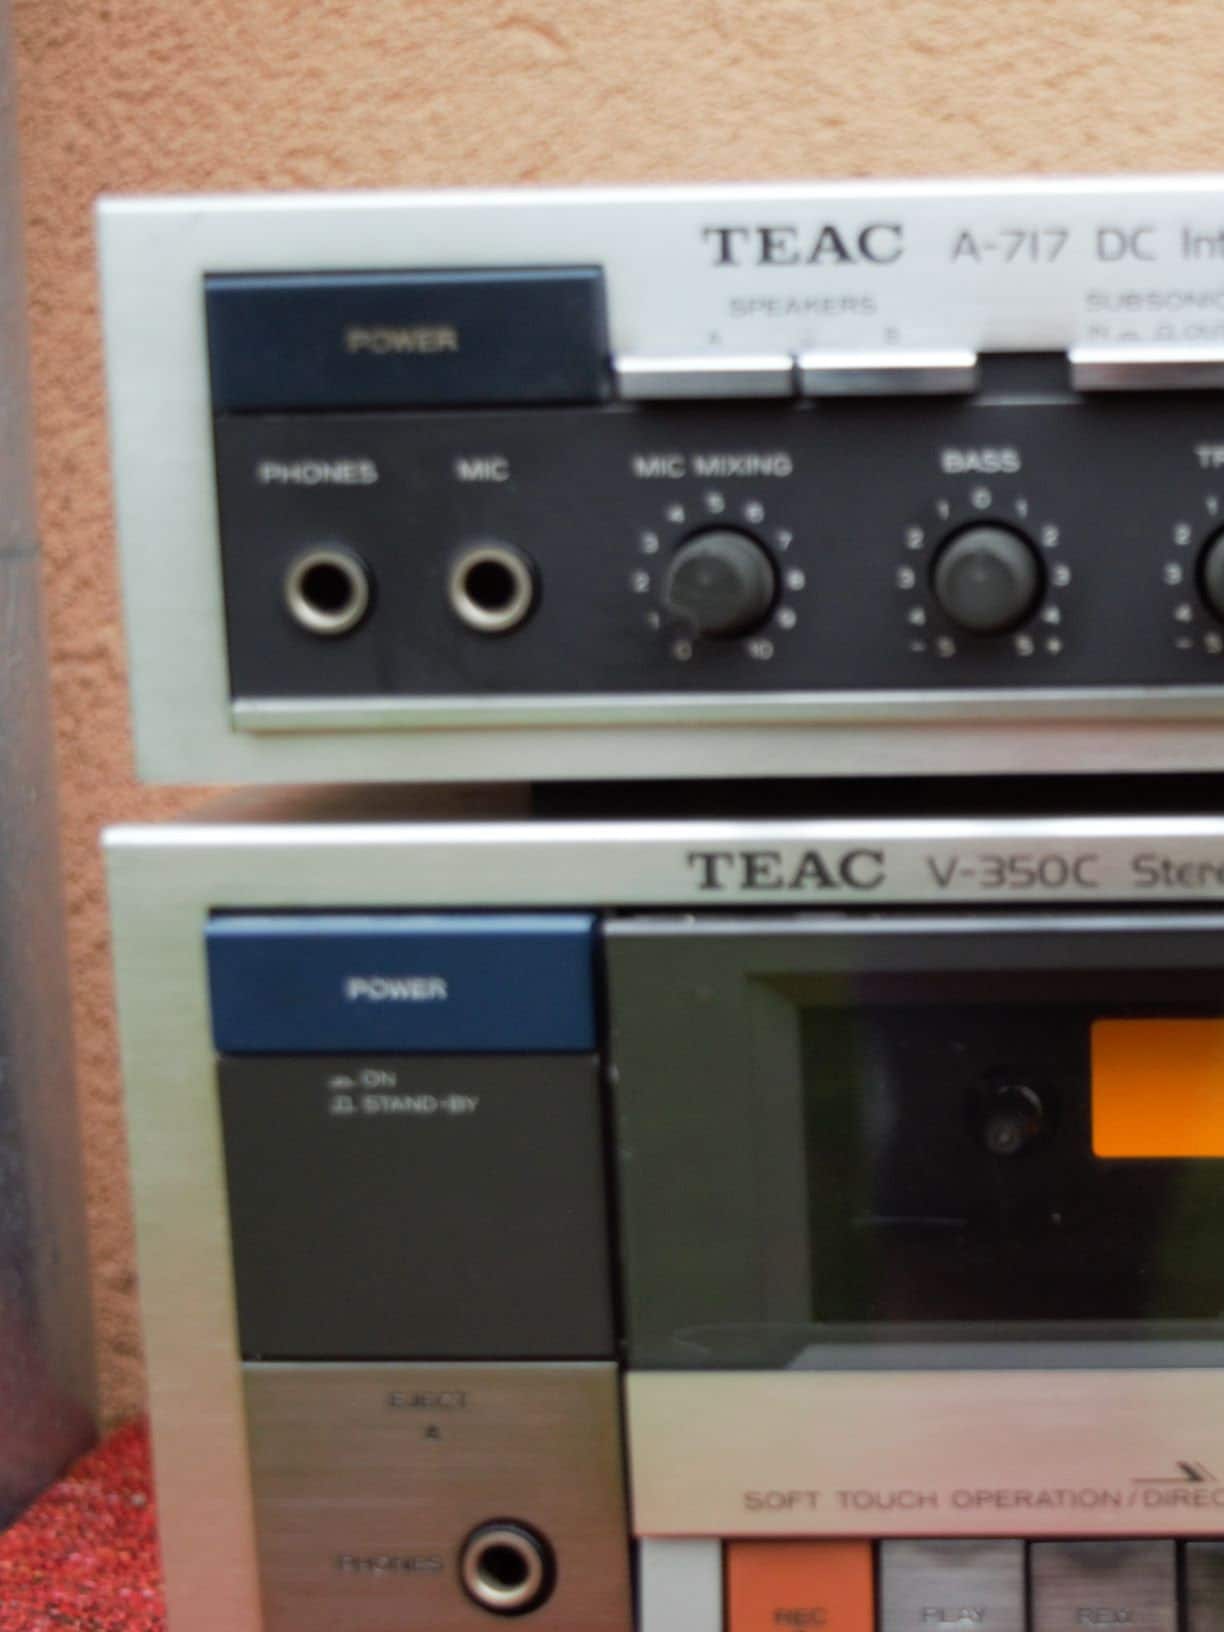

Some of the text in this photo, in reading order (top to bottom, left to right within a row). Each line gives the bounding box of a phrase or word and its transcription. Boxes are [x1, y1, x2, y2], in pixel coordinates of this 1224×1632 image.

[703, 223, 905, 266] TEAC
[951, 228, 1070, 263] A-717
[1096, 227, 1158, 262] DC
[729, 296, 879, 318] SPEAKERS
[344, 326, 460, 354] POWER
[455, 457, 510, 482] MIC
[633, 453, 794, 479] MIC MIXING
[941, 448, 1021, 473] BASS
[258, 460, 378, 486] PHONES
[707, 492, 725, 513] 5
[971, 486, 992, 510] 0
[1016, 498, 1028, 518] 1
[1206, 495, 1218, 515] 1
[667, 504, 686, 524] 4
[744, 503, 764, 524] 6
[937, 499, 950, 520] 1
[641, 533, 660, 554] 3
[779, 532, 793, 551] 7
[907, 526, 924, 549] 2
[1042, 525, 1059, 547] 2
[1174, 523, 1191, 545] 2
[632, 572, 651, 592] 2
[786, 570, 805, 591] 8
[897, 565, 915, 589] 3
[1054, 563, 1071, 586] 3
[1164, 562, 1182, 585] 3
[648, 611, 661, 630] 1
[778, 608, 797, 629] 9
[909, 605, 926, 626] 4
[1042, 604, 1060, 624] 4
[1174, 603, 1192, 622] 4
[673, 641, 692, 661] 0
[748, 641, 774, 661] 10
[937, 636, 956, 657] 5
[1015, 634, 1034, 656] 5
[1204, 632, 1223, 653] 5
[688, 850, 885, 891] TEAC
[926, 854, 1100, 889] V-350C
[345, 976, 448, 1002] POWER
[362, 1069, 396, 1089] ON
[362, 1093, 479, 1114] STAND-BY
[389, 1390, 467, 1410] EJECT
[744, 1489, 822, 1514] SOFT
[839, 1488, 939, 1512] TOUCH
[334, 1553, 444, 1575] PHONES
[773, 1607, 827, 1627] REC
[921, 1605, 988, 1625] PLAY
[1078, 1607, 1133, 1626] REW
